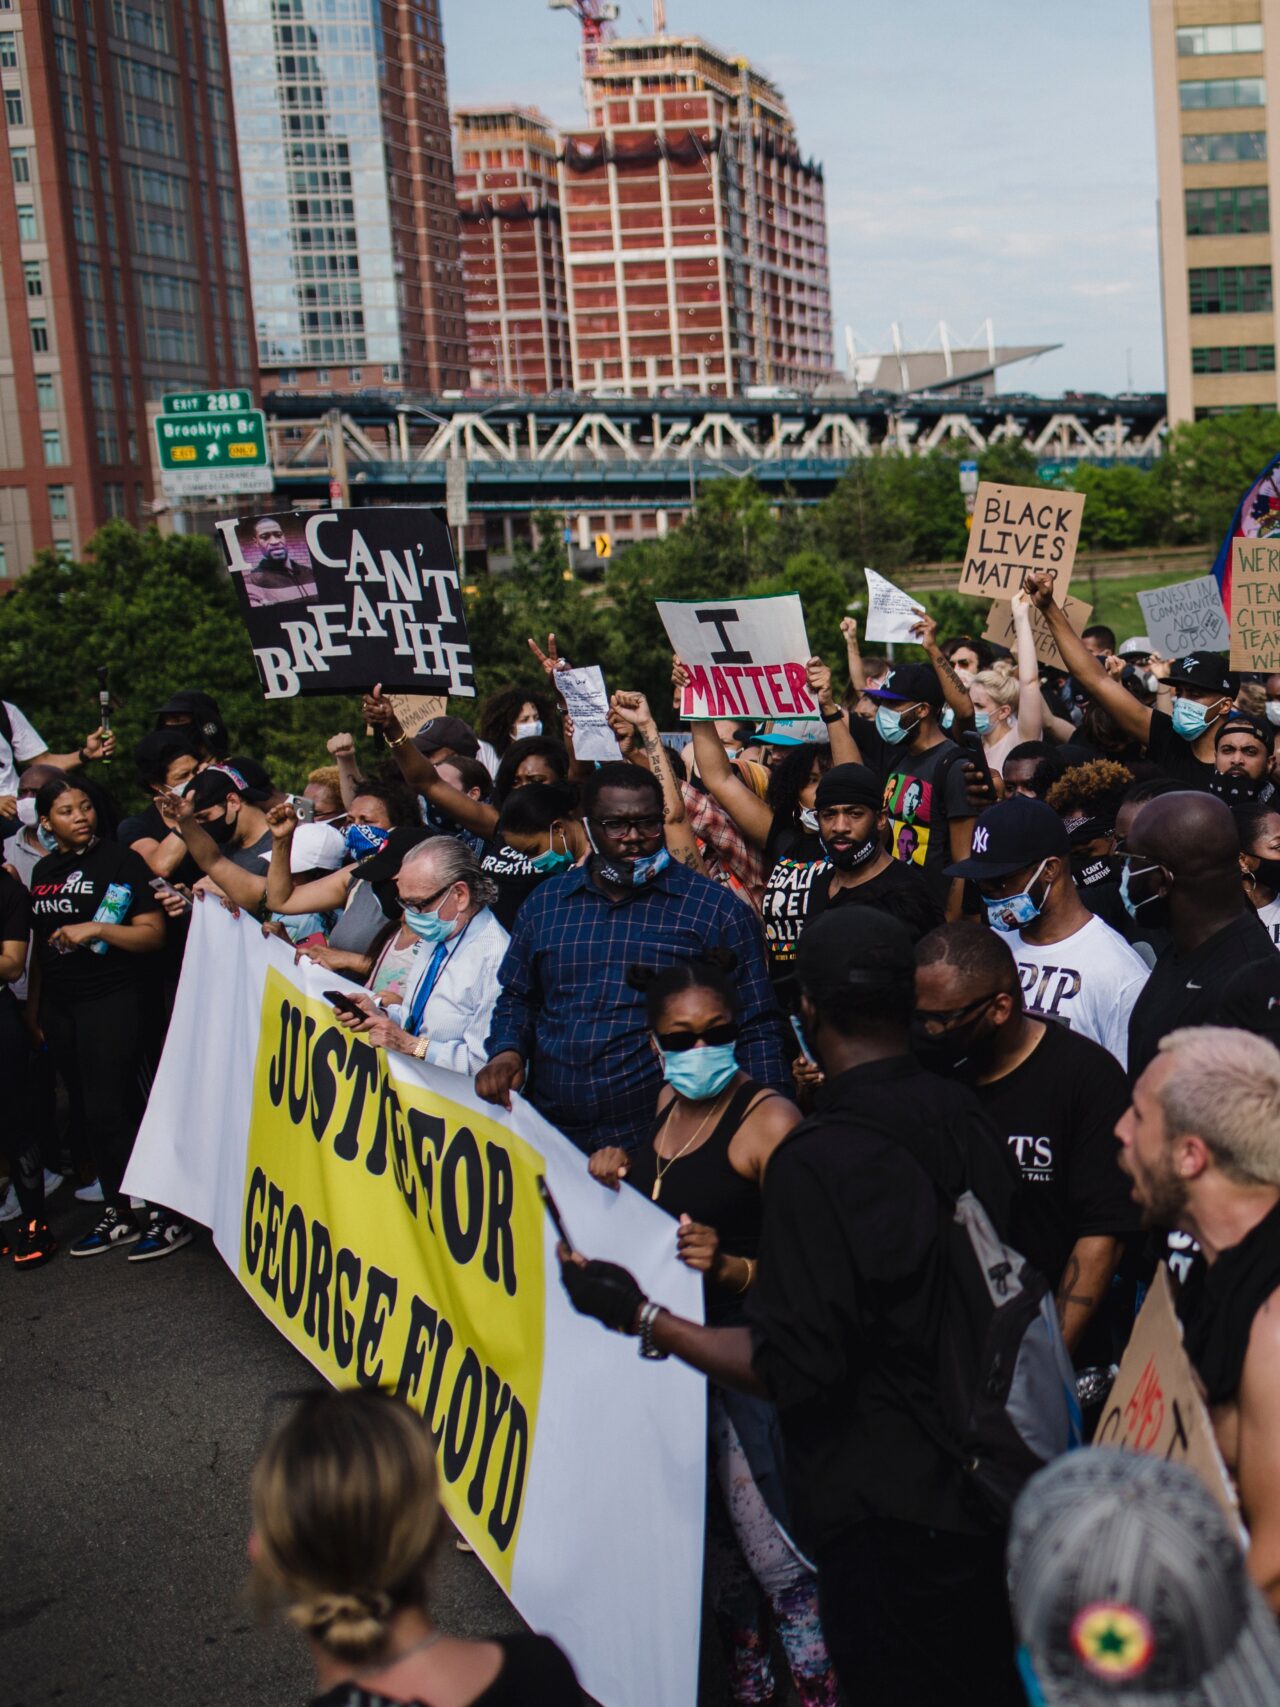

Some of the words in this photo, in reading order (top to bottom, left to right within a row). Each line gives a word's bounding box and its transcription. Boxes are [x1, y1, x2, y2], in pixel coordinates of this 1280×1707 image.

[172, 398, 199, 411] EXIT
[163, 421, 231, 440] Brooklyn
[236, 418, 256, 434] Br
[172, 448, 195, 460] EXIT
[229, 444, 255, 457] ONLY
[983, 497, 1073, 532] BLACK
[978, 529, 1066, 562] LIVES
[214, 518, 252, 573] I
[304, 513, 460, 624] CAN'T
[1197, 580, 1212, 598] IN
[1173, 609, 1201, 631] NOT
[252, 584, 476, 700] BREATHE
[694, 608, 754, 665] I
[1165, 629, 1208, 653] COPS
[682, 662, 817, 716] MATTER
[972, 825, 990, 854] NY
[1082, 865, 1112, 886] BREATHE
[1085, 860, 1104, 875] CAN'T
[407, 1107, 517, 1297] FOR
[245, 1166, 398, 1388] GEORGE
[393, 1294, 528, 1552] FLOYD
